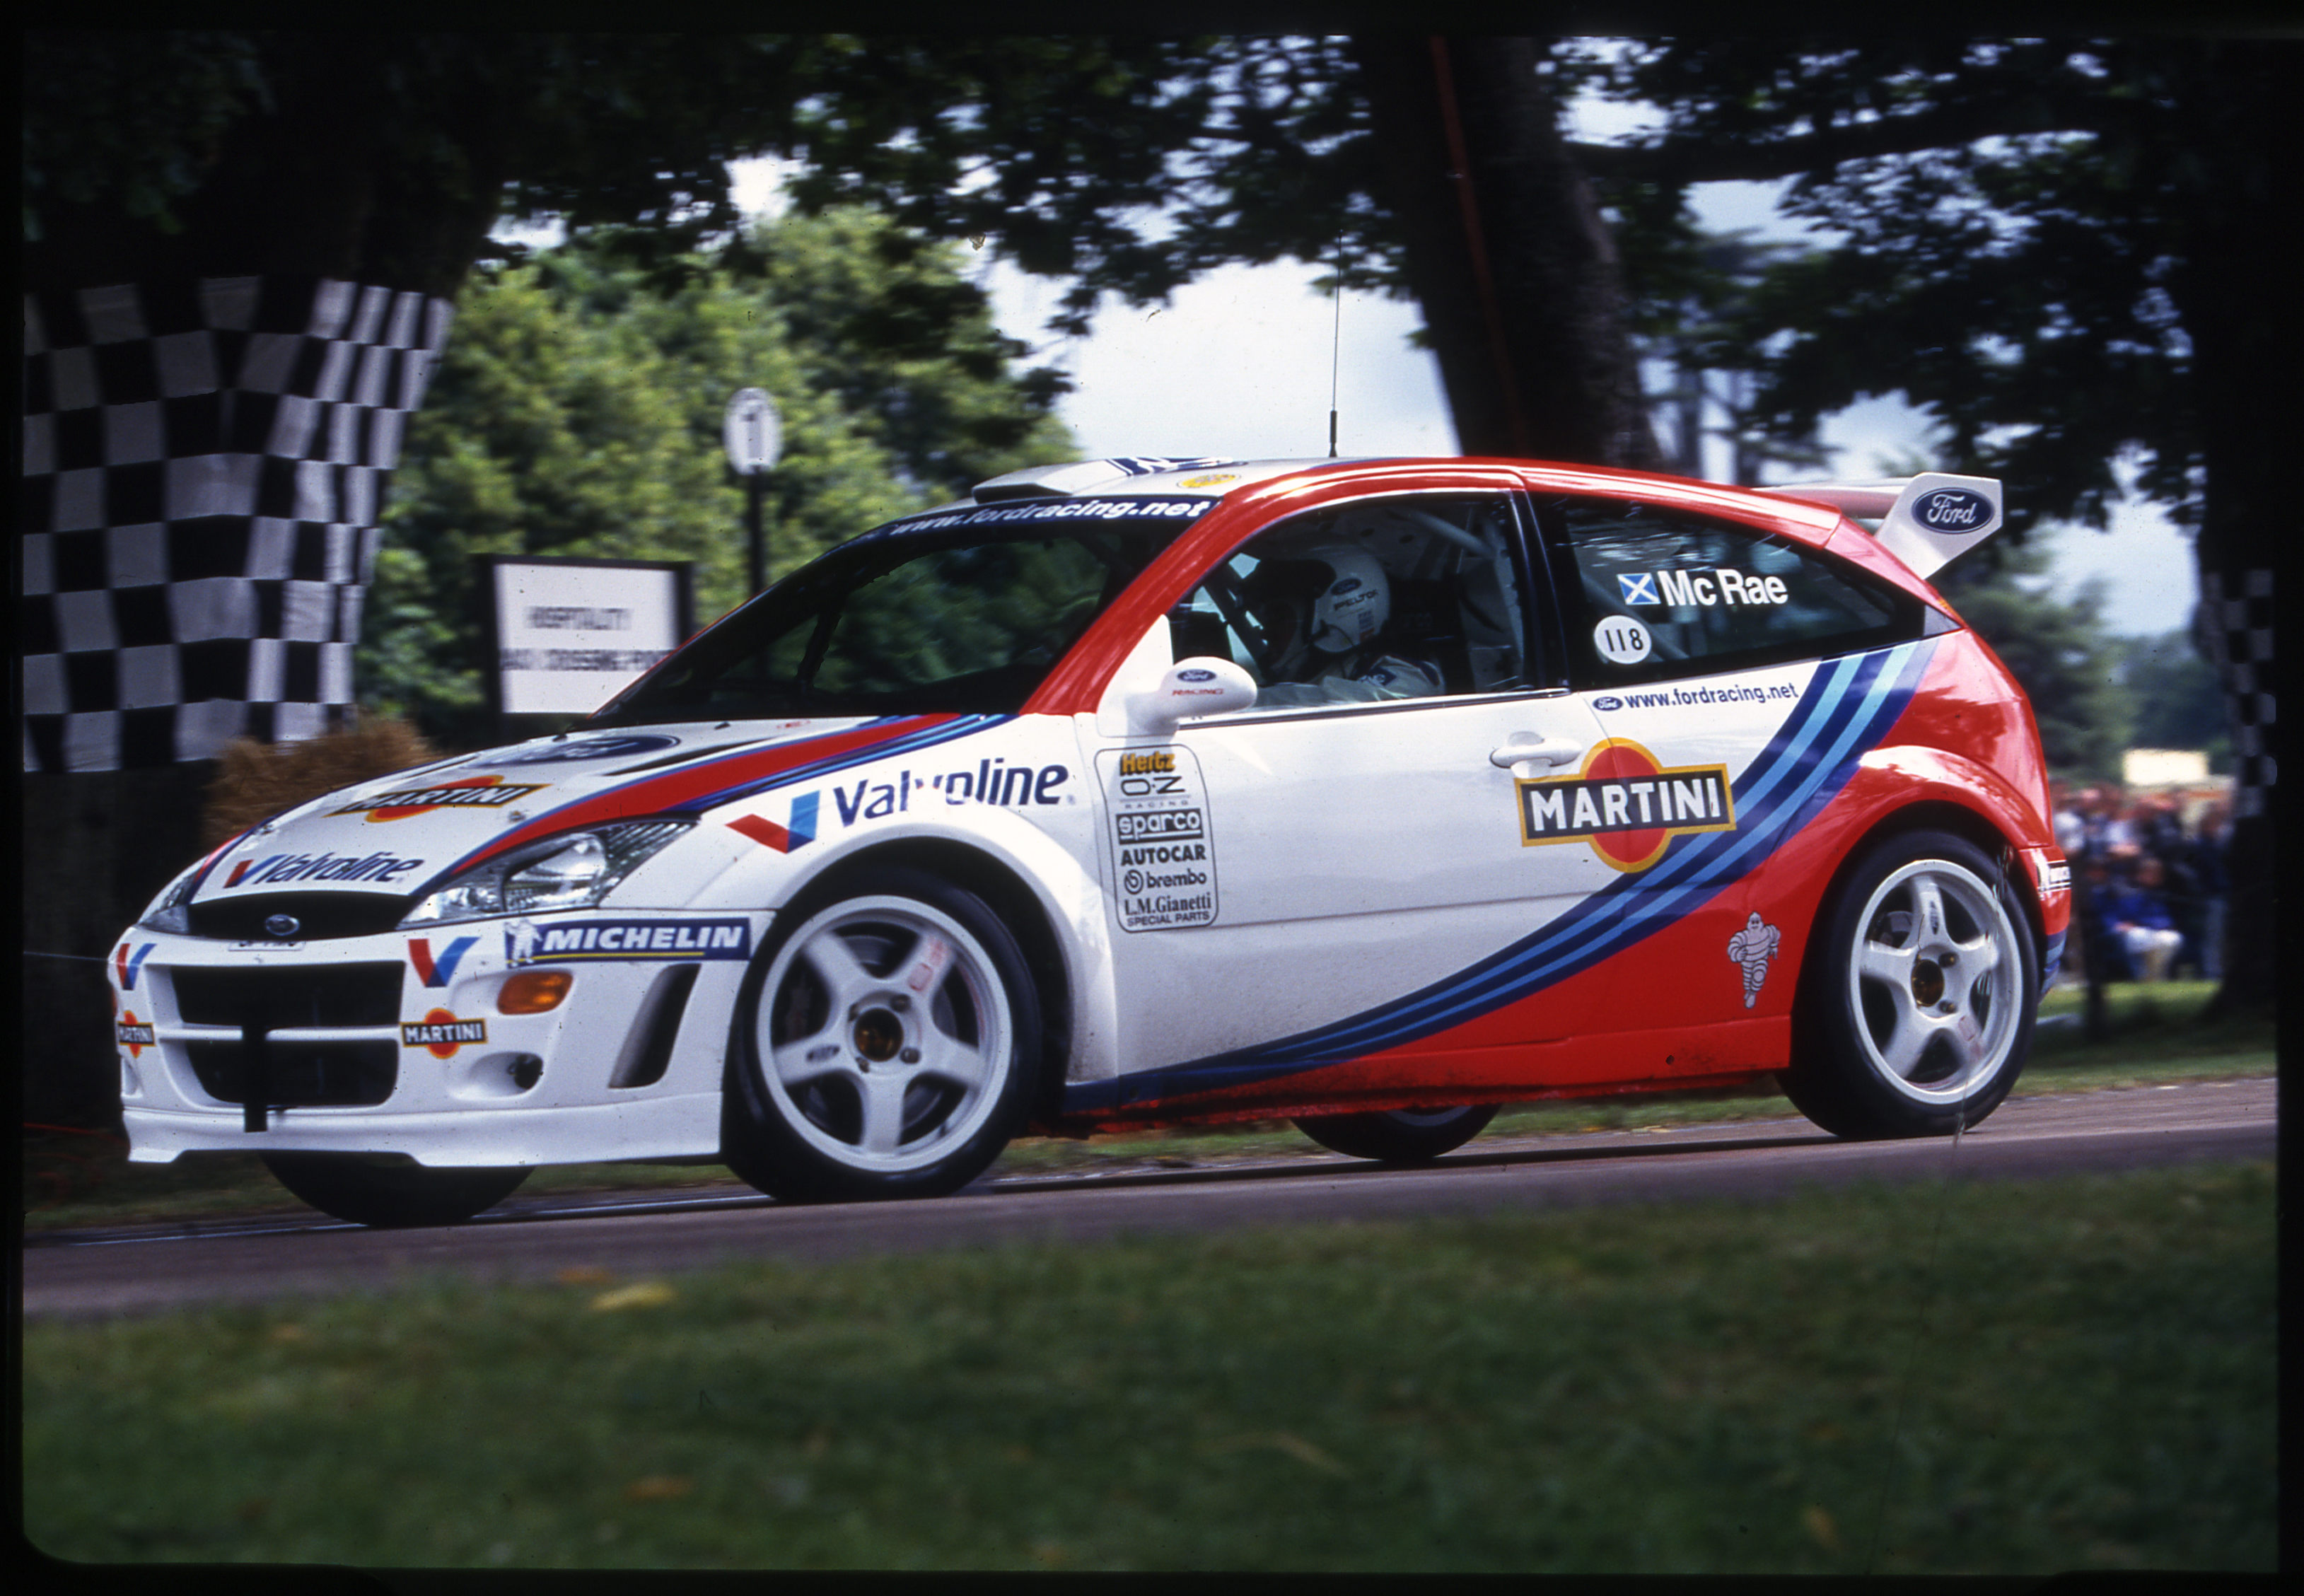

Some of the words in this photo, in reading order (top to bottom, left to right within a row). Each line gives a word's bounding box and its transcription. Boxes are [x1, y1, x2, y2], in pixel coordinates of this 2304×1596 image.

[889, 499, 1211, 535] www.fordracing.net
[1927, 494, 1977, 523] Ford
[1605, 628, 1643, 651] 118
[1624, 682, 1799, 709] www.fordracing.net
[1119, 751, 1175, 776] Hertz
[1124, 800, 1189, 809] RACING
[1530, 778, 1721, 832] MARTINI
[1118, 812, 1201, 841] sparco
[1121, 844, 1206, 866] AUTOCAR
[252, 851, 425, 885] Valvoline
[1146, 868, 1207, 888] brembo
[1127, 914, 1173, 926] SPECIAL
[1175, 911, 1210, 923] PARTS
[542, 926, 743, 950] MICHELIN
[405, 1023, 482, 1042] MARTINI
